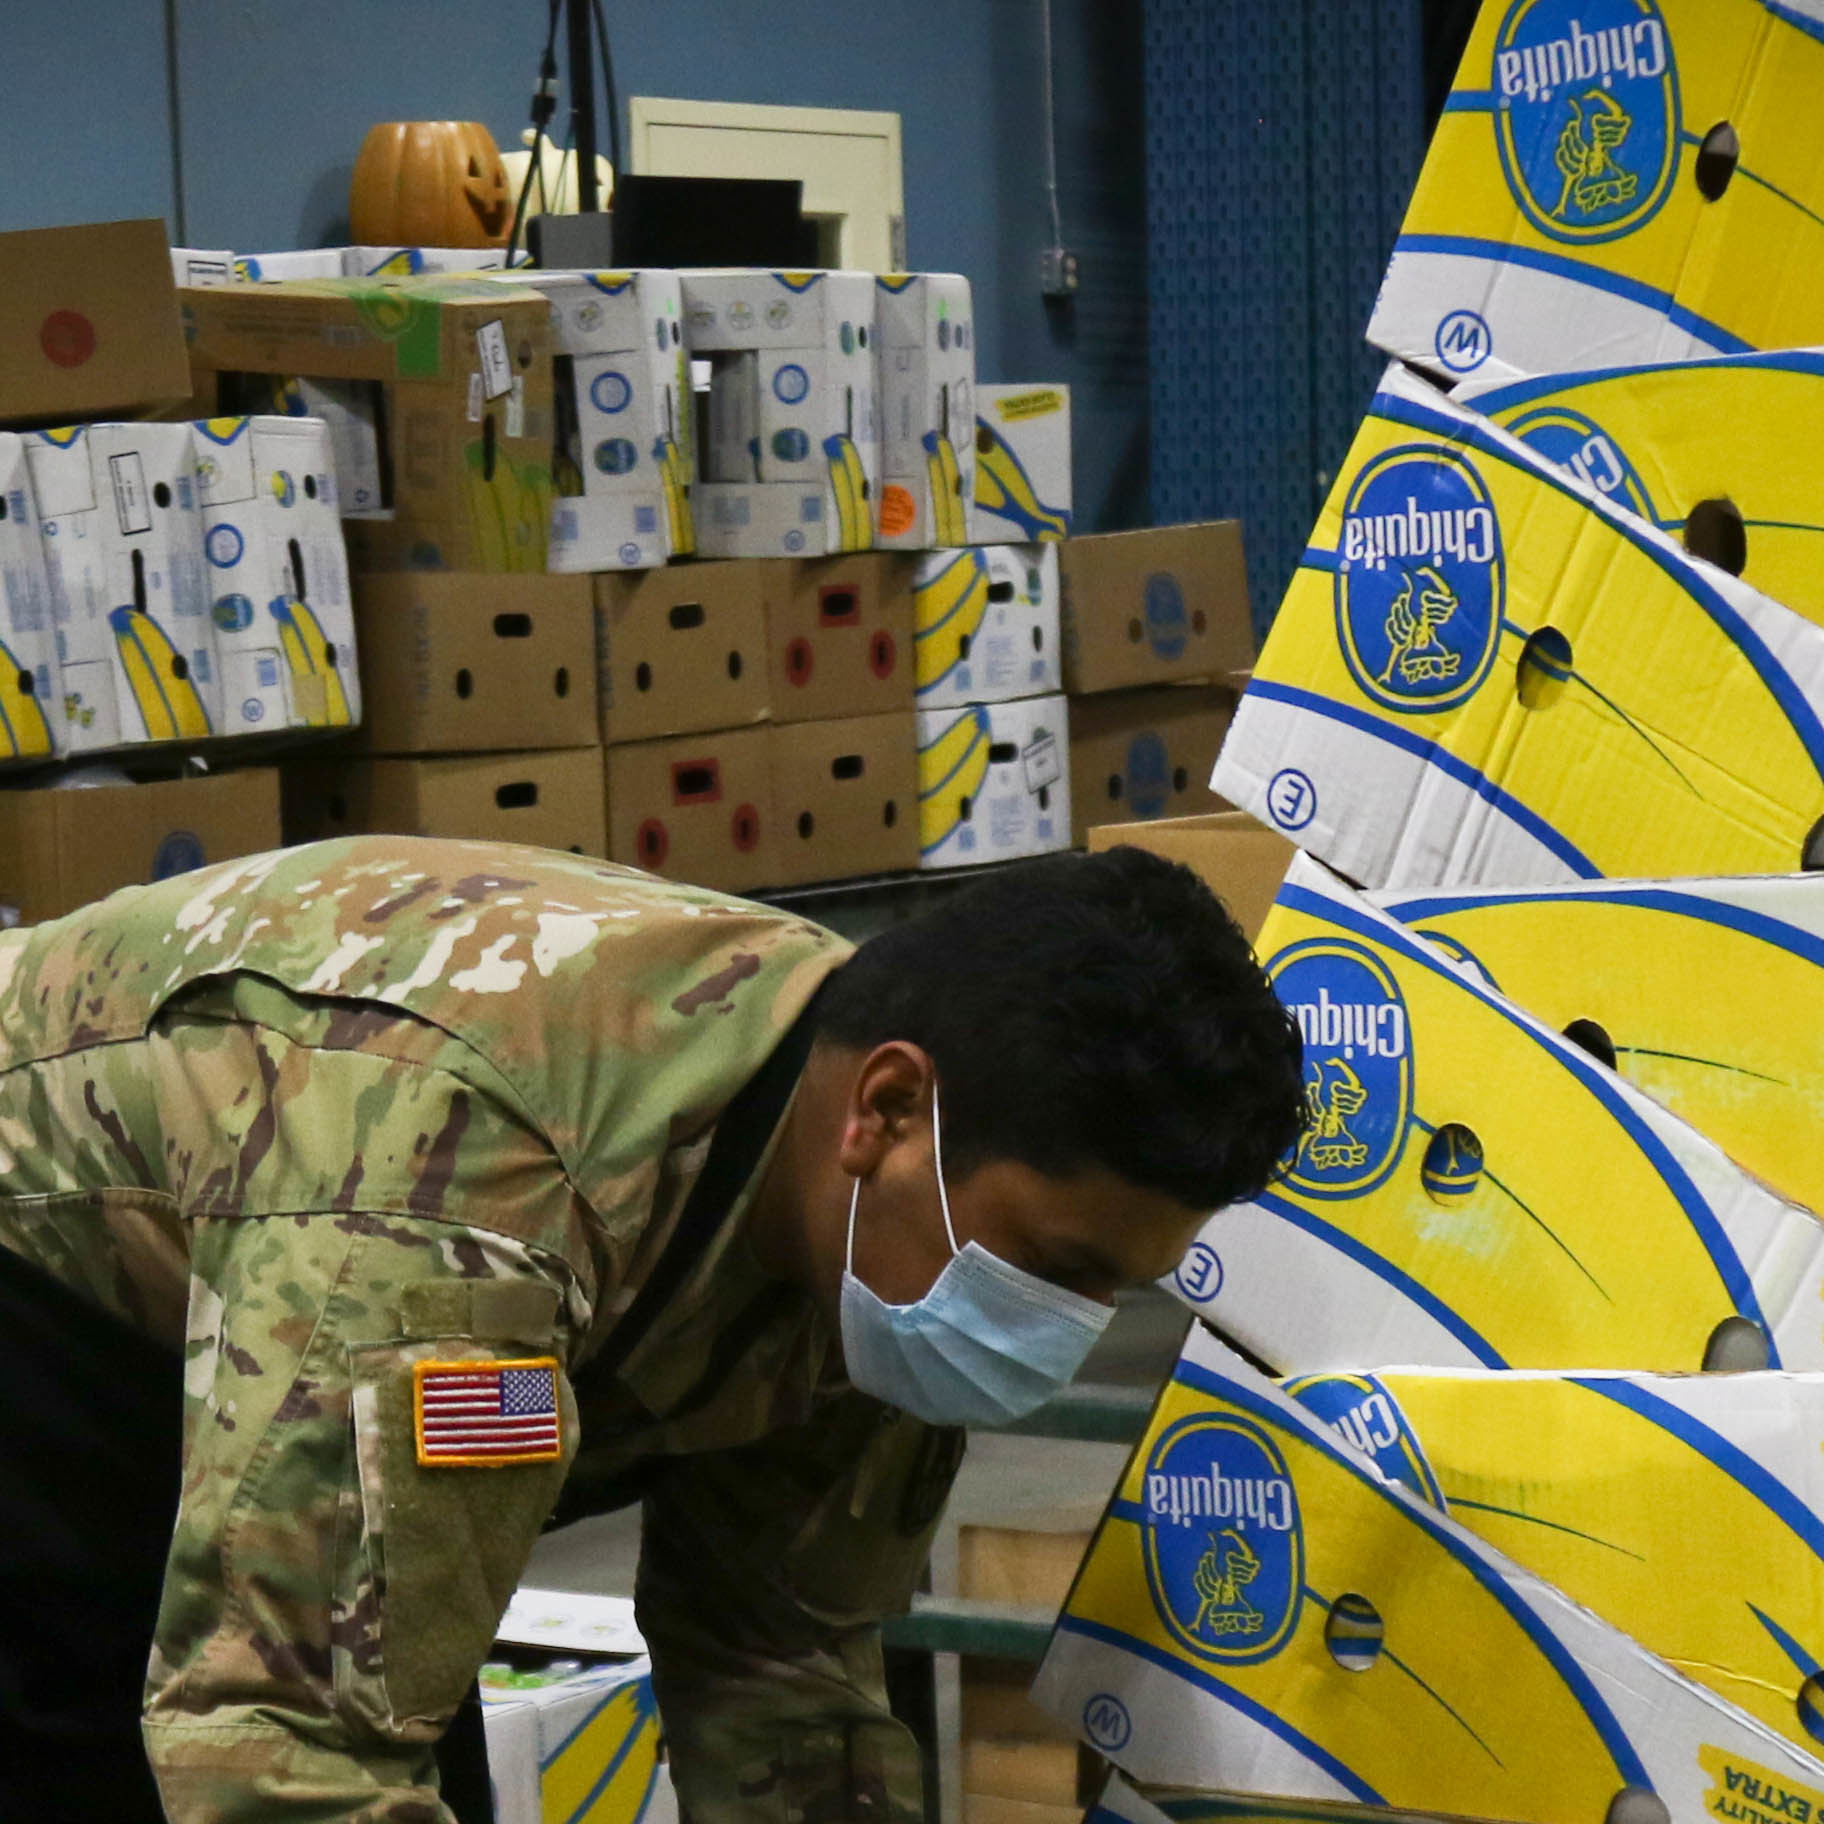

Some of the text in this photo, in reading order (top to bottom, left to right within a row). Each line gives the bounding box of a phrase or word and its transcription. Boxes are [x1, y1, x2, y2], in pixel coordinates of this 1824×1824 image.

[1498, 19, 1667, 103] Chiquita
[1345, 496, 1495, 571] Chiquita
[1286, 987, 1405, 1060] Chiqu
[1148, 1461, 1293, 1531] Chiquita
[1723, 1765, 1812, 1822] EXTRA
